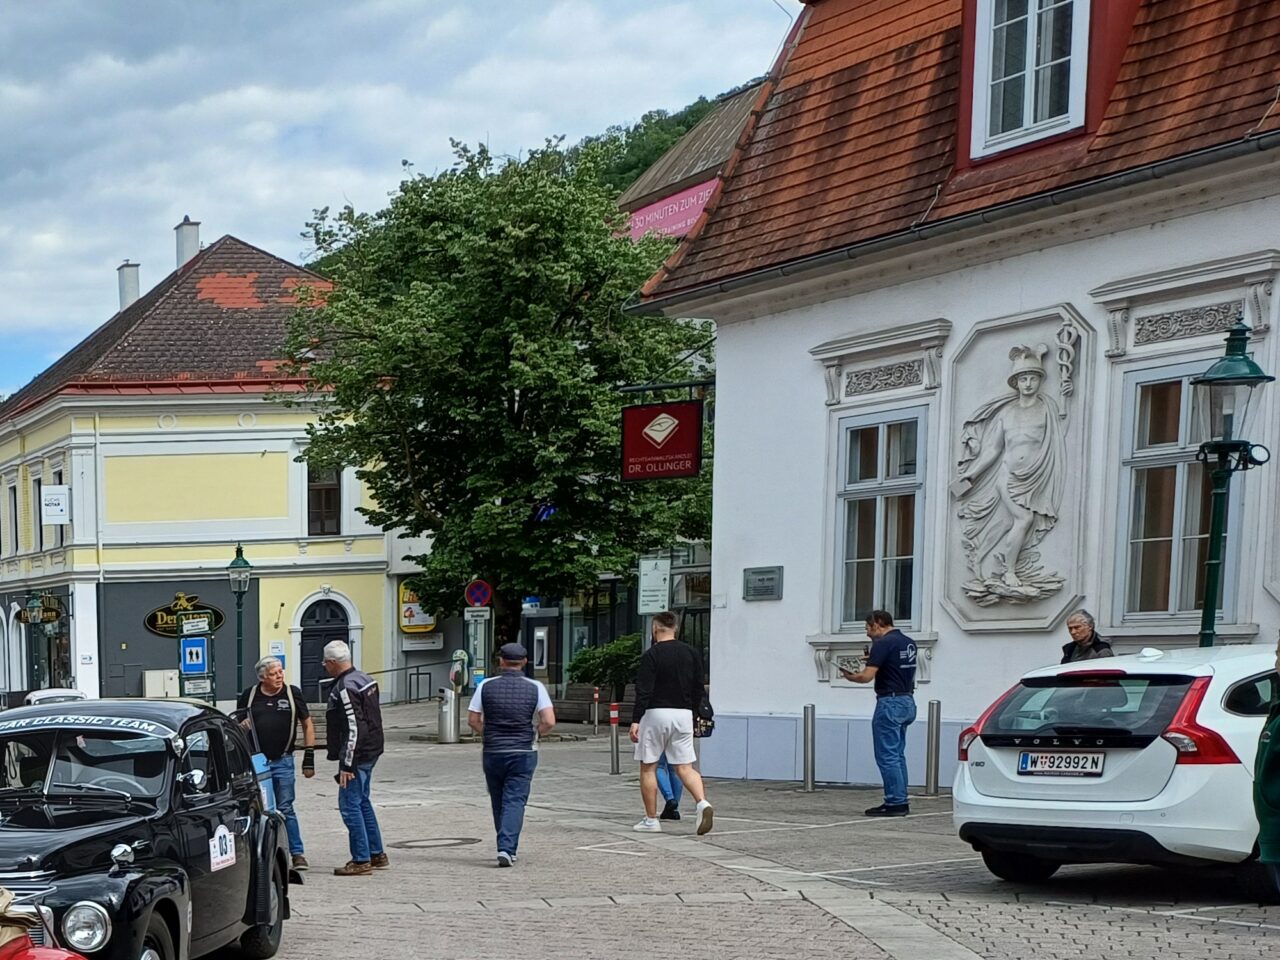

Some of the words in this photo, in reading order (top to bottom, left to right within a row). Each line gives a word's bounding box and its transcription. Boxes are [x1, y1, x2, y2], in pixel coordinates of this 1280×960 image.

[646, 202, 679, 225] MINUTEN
[680, 195, 697, 213] ZUM
[628, 464, 643, 473] DR.
[646, 460, 692, 472] OLLINGER
[31, 715, 104, 726] CLASSIC
[110, 718, 157, 732] TEAM
[1030, 755, 1039, 769] W
[1048, 755, 1087, 769] 92992
[218, 833, 228, 857] 03
